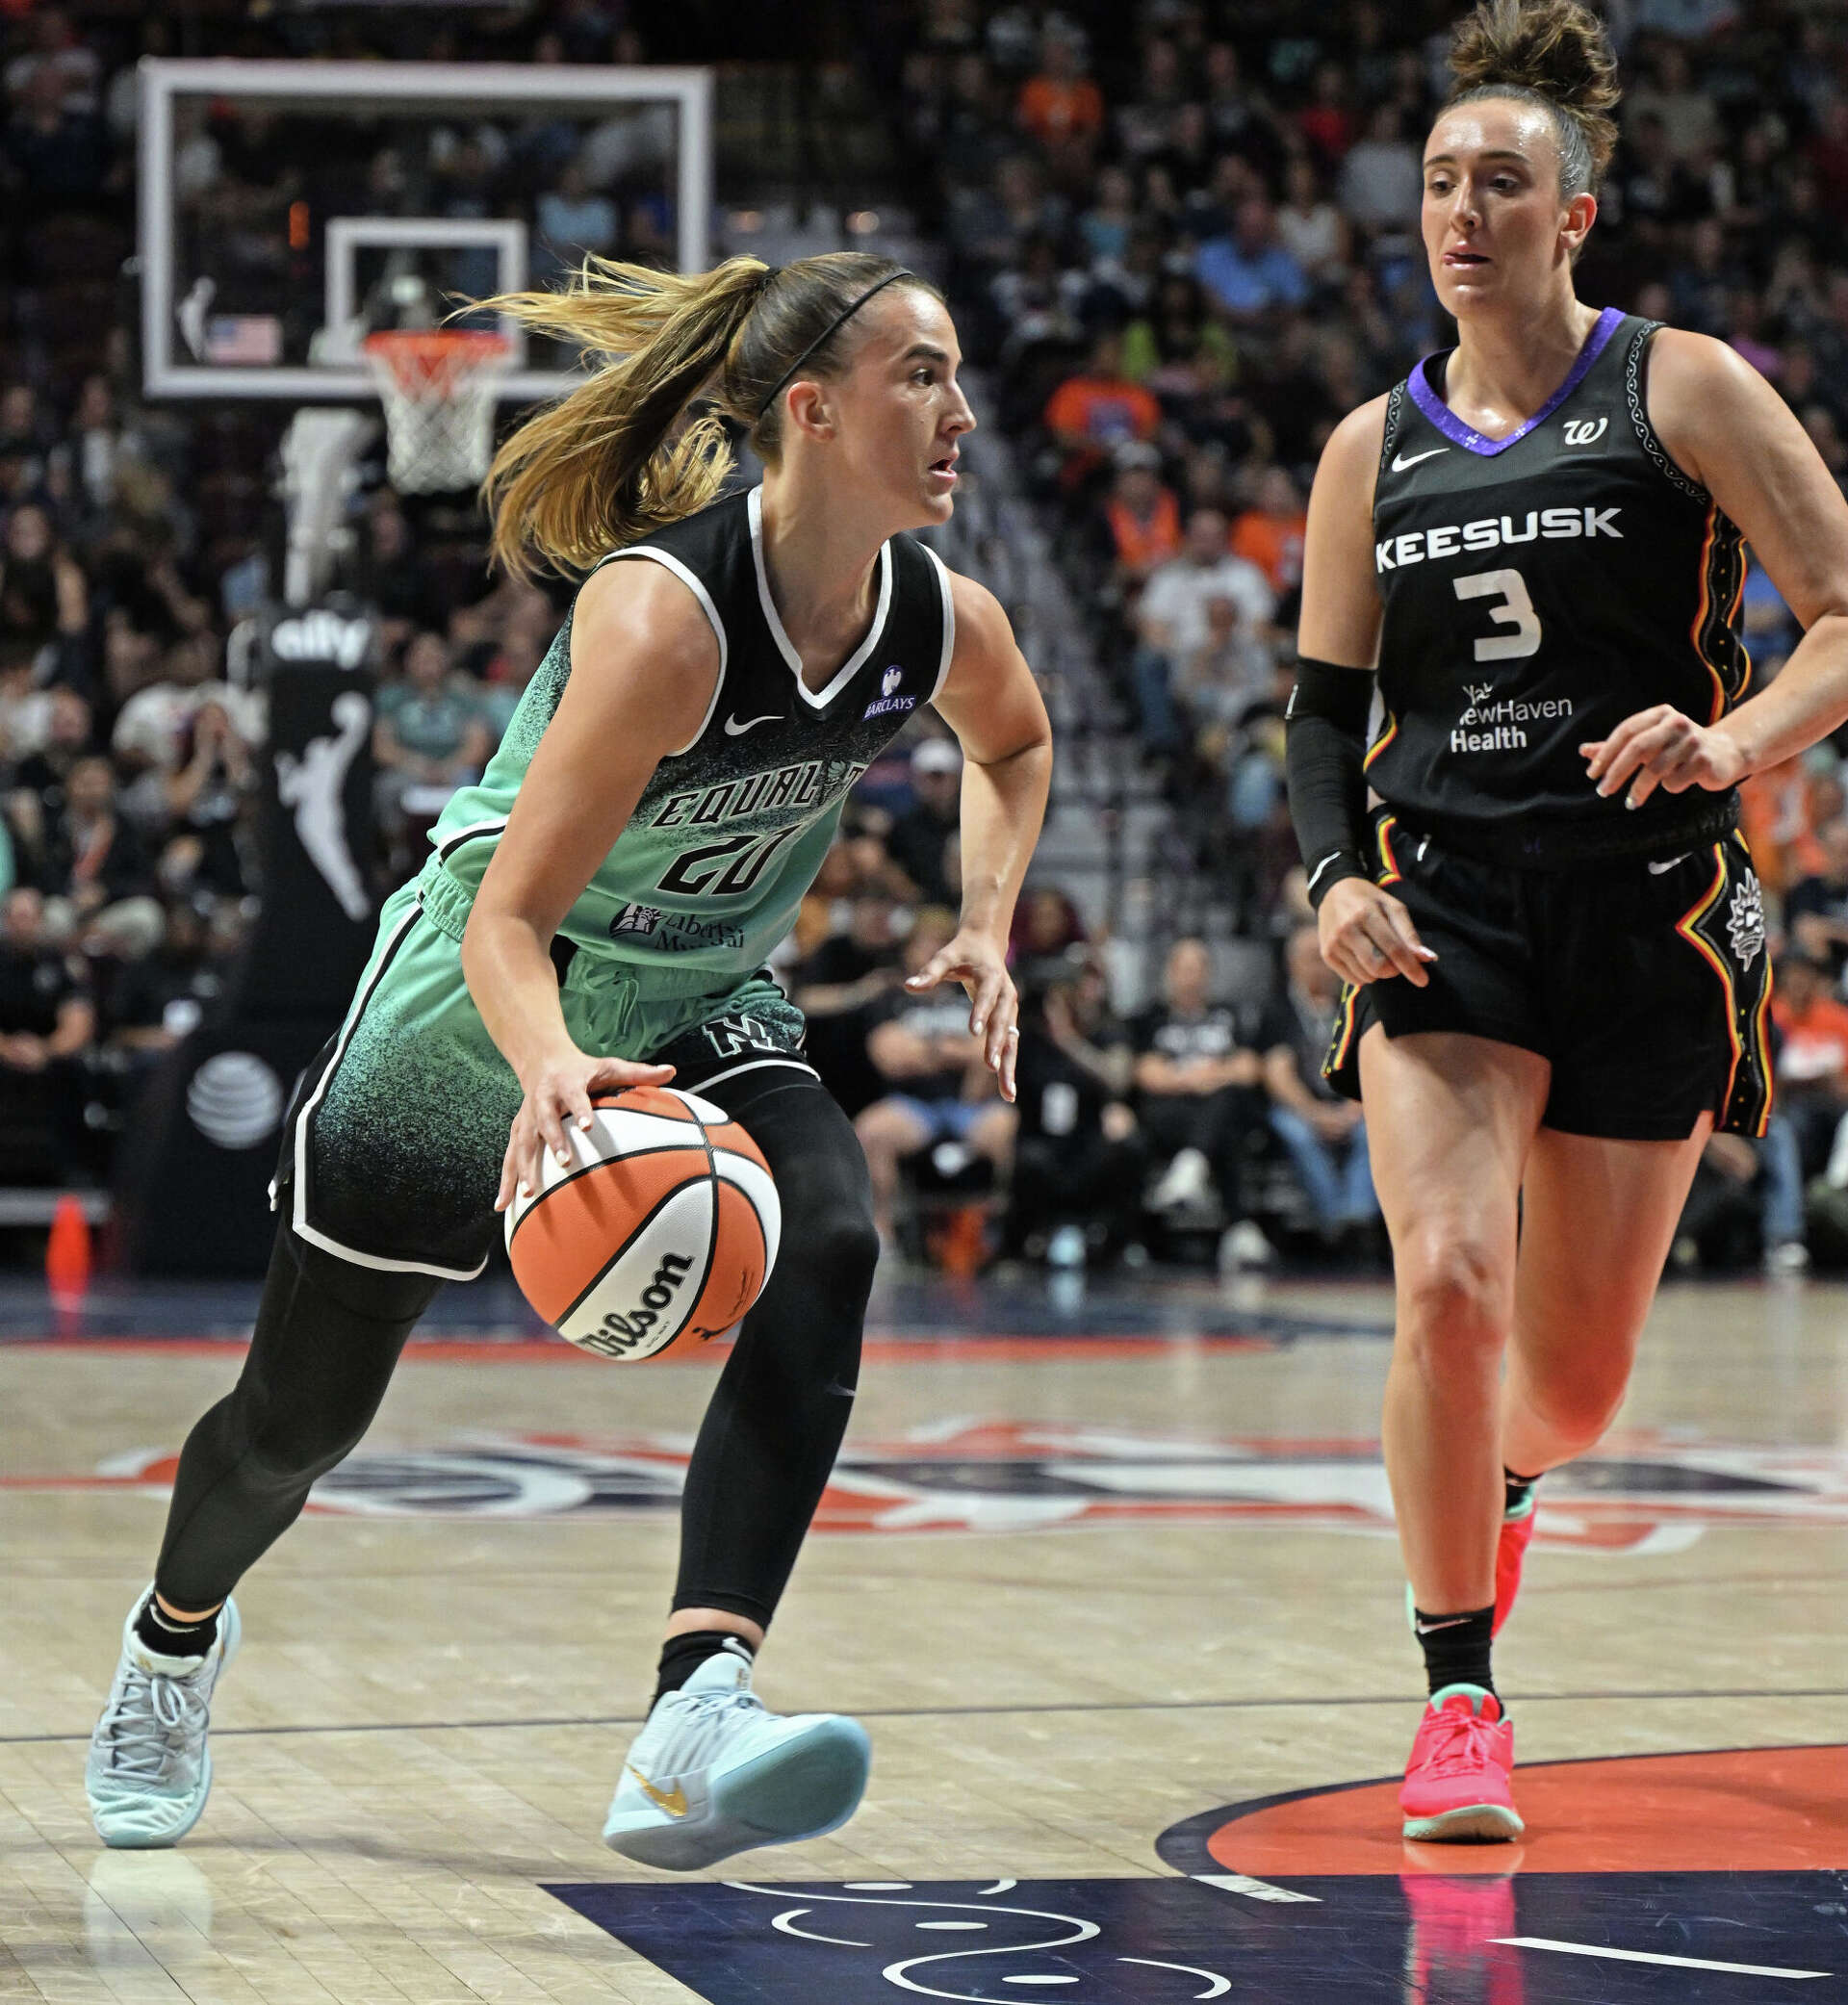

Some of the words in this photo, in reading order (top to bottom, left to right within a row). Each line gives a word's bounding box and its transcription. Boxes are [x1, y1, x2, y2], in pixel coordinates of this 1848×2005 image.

[1375, 506, 1625, 574] KEESUSK
[1452, 568, 1542, 662] 3
[863, 696, 915, 719] BARCLAYS
[1459, 699, 1573, 726] ewHaven
[1450, 726, 1527, 753] Health
[654, 823, 803, 896] 20
